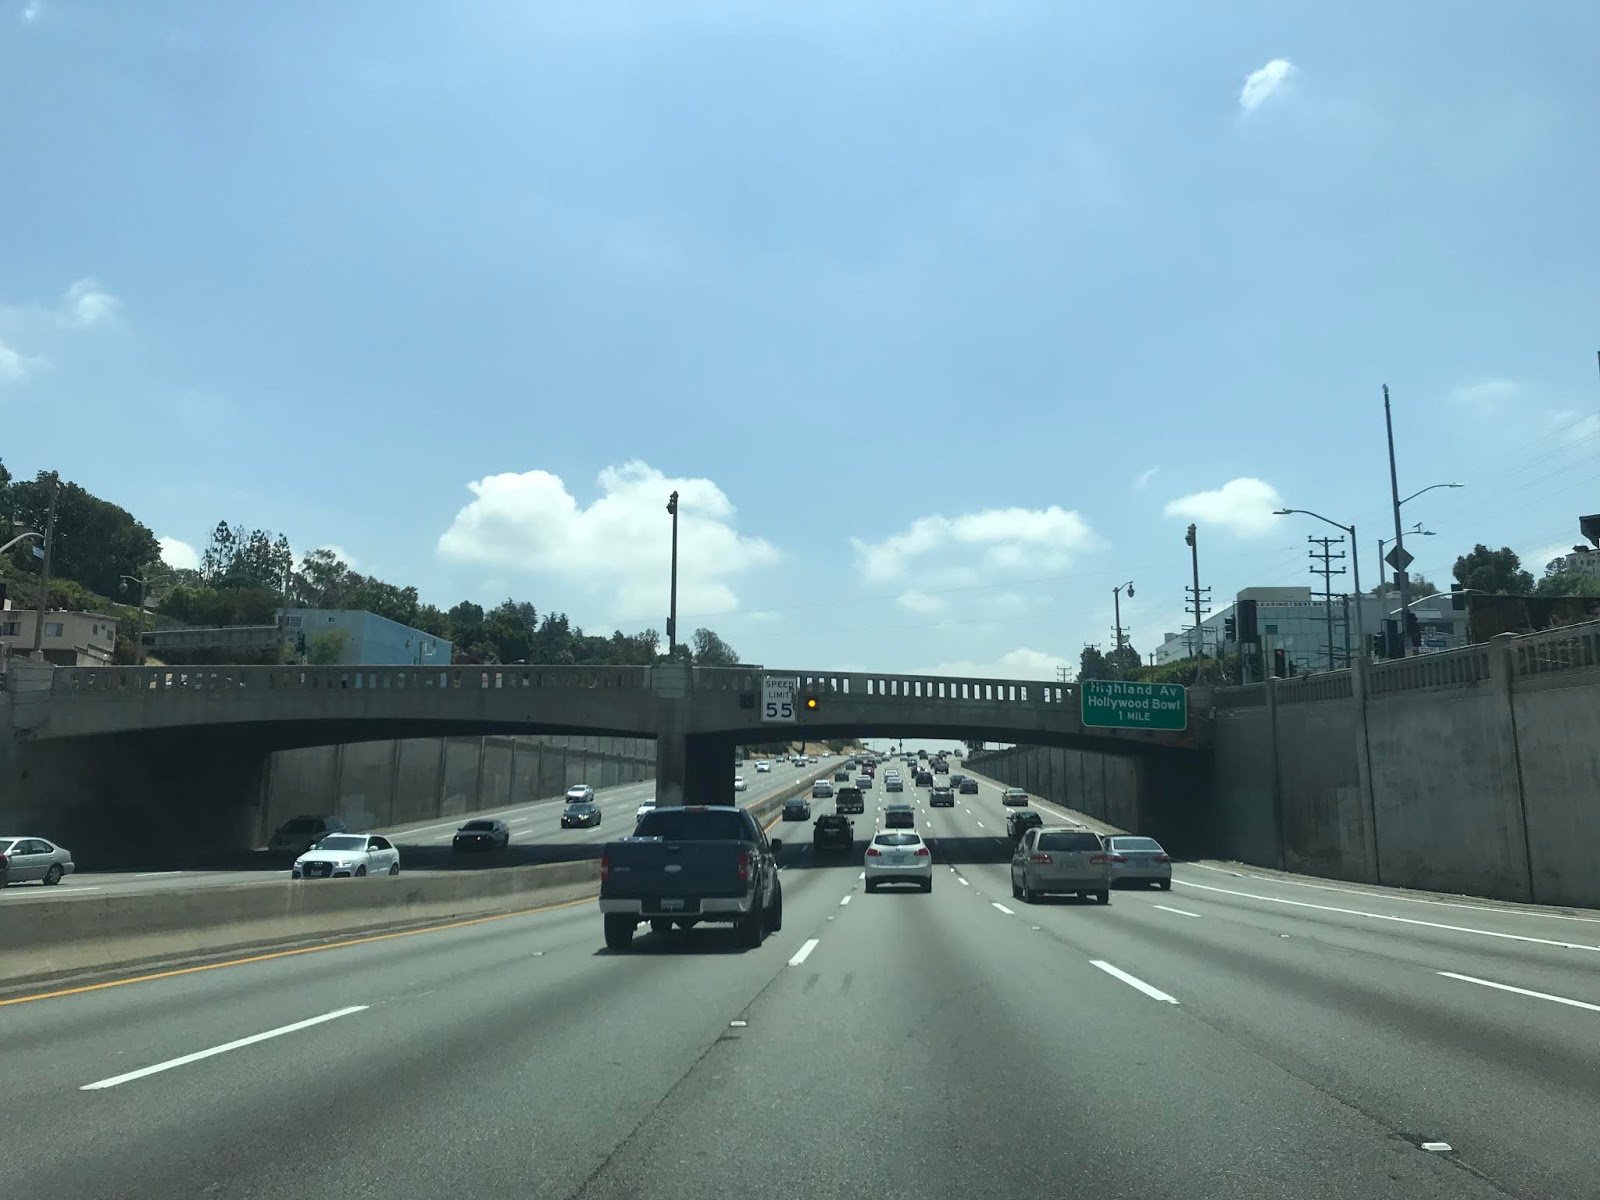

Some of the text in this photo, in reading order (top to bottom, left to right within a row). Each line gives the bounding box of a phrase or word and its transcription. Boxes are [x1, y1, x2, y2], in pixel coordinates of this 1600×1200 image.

[1160, 685, 1177, 696] Av
[1088, 696, 1180, 710] Hollywood Bowl
[766, 702, 793, 718] 55
[1118, 711, 1151, 721] 1 MILE
